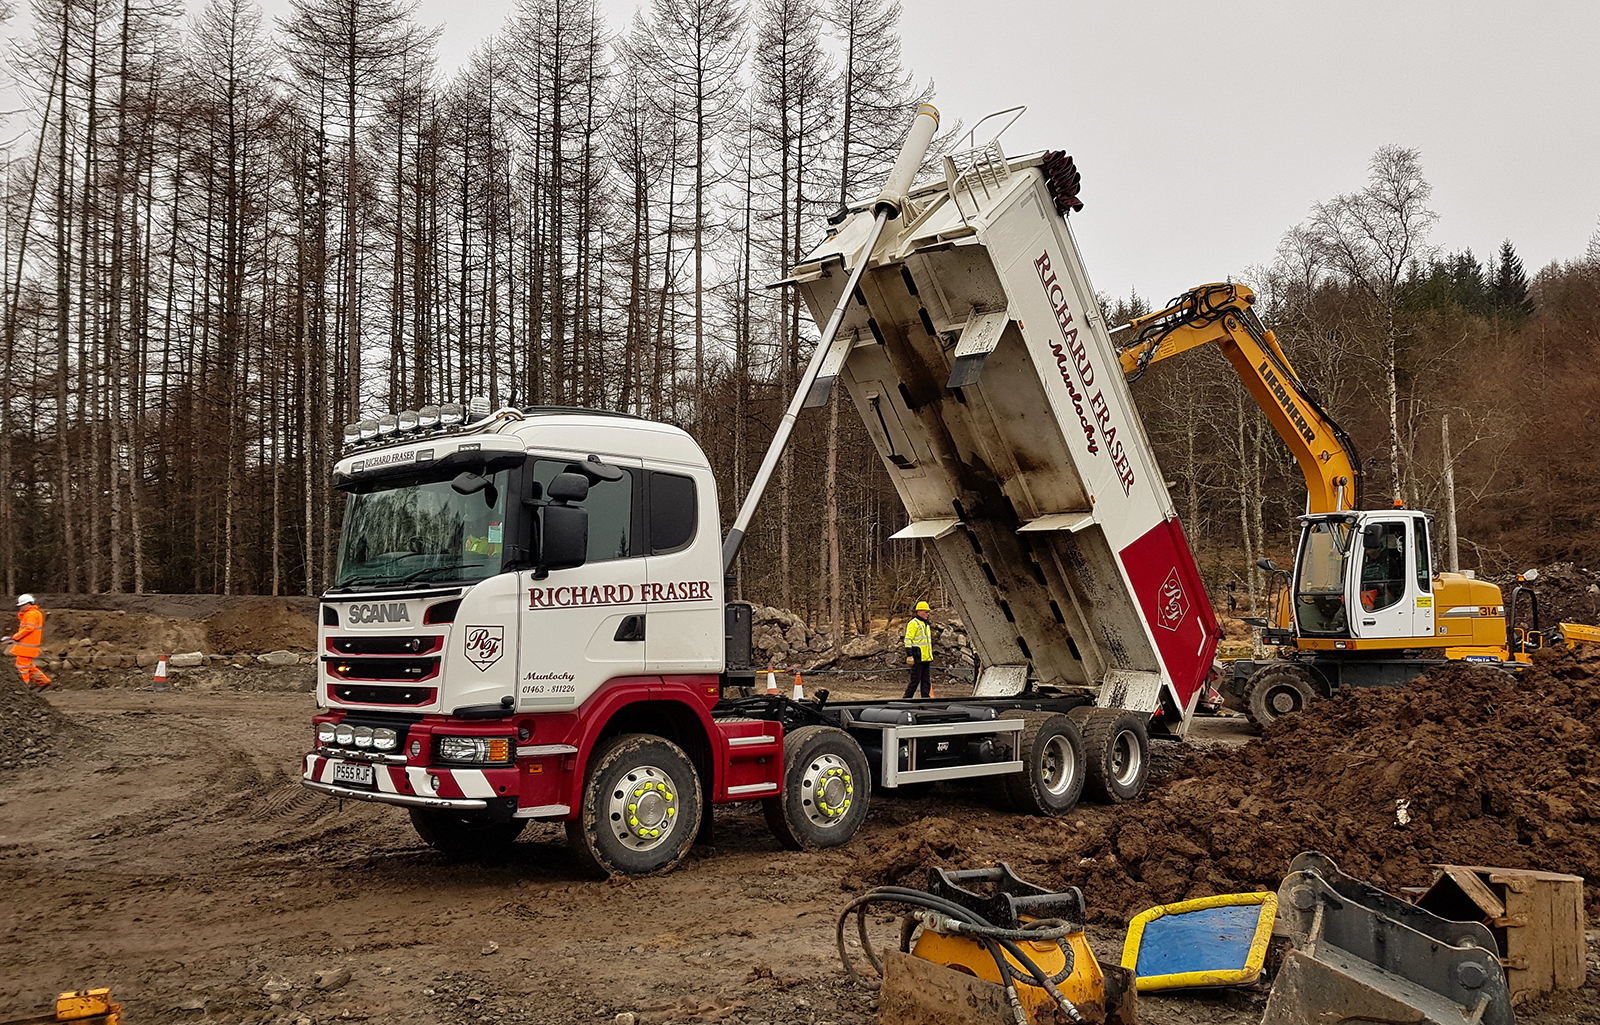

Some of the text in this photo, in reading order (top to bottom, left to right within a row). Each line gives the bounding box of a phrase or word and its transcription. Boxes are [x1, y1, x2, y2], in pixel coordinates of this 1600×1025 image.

[1034, 249, 1136, 495] RICHARD FRASER
[1048, 338, 1100, 457] Munlochy
[1258, 361, 1316, 446] LIEBHERR
[365, 451, 415, 468] RICHARD FRASER
[528, 580, 713, 608] RICHARD FRASER
[348, 602, 411, 624] SCANIA
[1479, 606, 1498, 617] 314
[523, 672, 575, 682] Munlochy
[522, 685, 545, 693] 01463
[550, 684, 575, 693] 811226
[336, 765, 370, 781] P555 RJF
